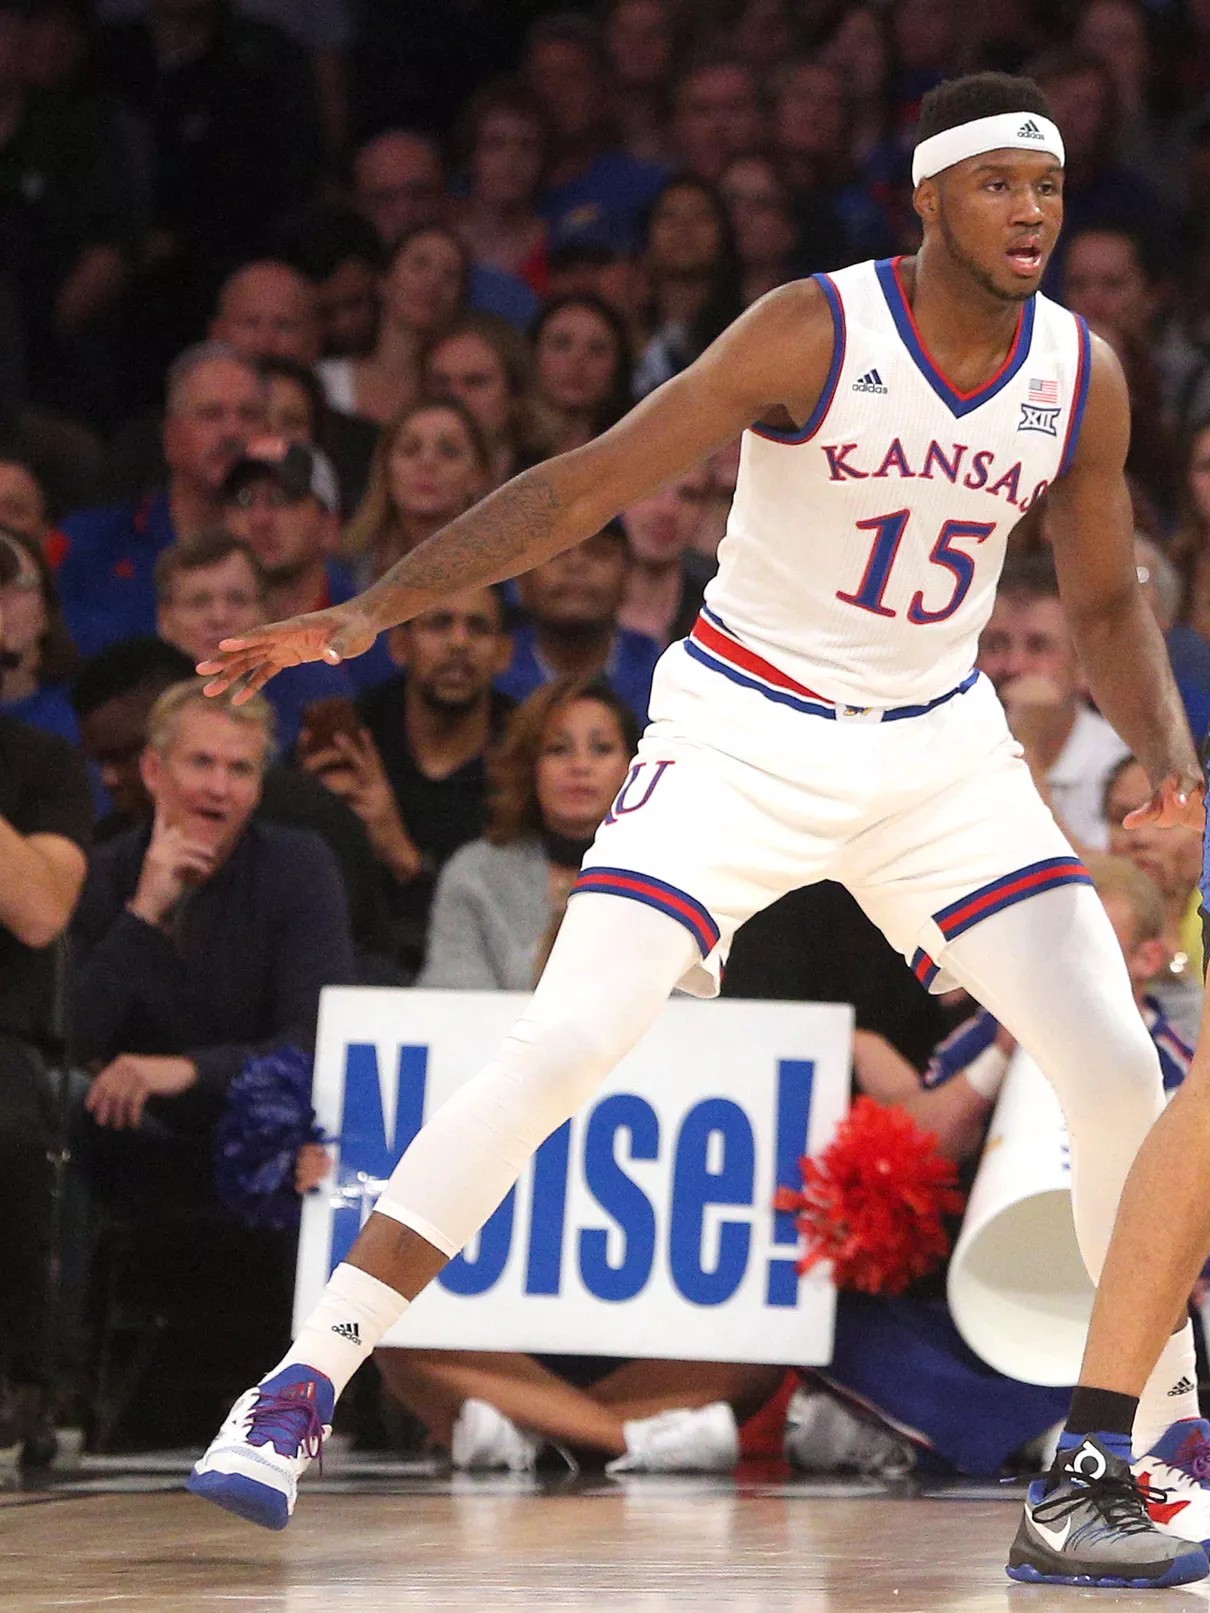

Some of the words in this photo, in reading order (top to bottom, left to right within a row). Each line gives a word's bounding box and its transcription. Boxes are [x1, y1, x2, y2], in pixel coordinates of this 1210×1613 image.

[1017, 131, 1045, 140] adidas
[852, 383, 888, 394] adidas
[820, 437, 1048, 513] KANSAS
[835, 508, 997, 625] 15
[604, 760, 676, 826] U
